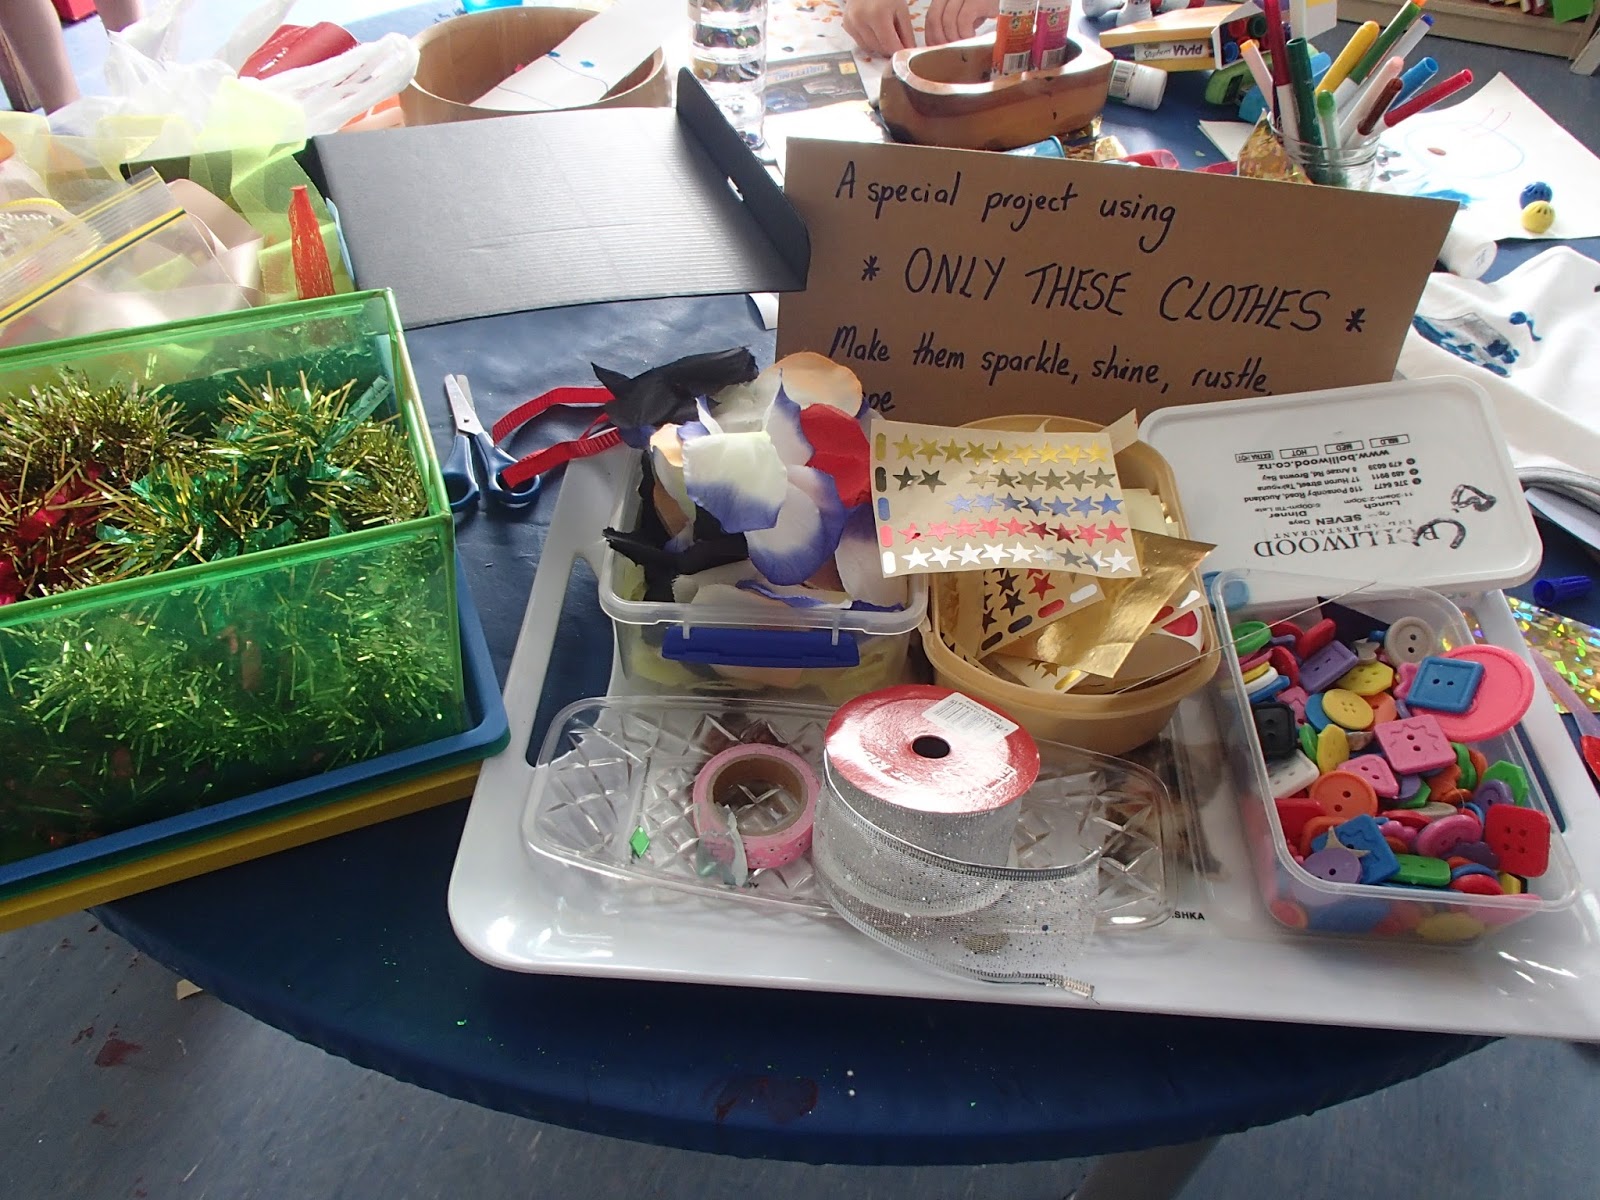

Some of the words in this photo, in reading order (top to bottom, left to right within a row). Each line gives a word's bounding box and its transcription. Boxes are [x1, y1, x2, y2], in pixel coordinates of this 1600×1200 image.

[1173, 44, 1203, 56] Vivid
[836, 160, 857, 199] A
[867, 171, 961, 219] special
[981, 181, 1078, 233] project
[1099, 195, 1175, 253] using
[904, 247, 1005, 300] ONLY
[1025, 262, 1133, 317] THESE
[1159, 276, 1331, 333] CLOTHES
[828, 325, 890, 363] Make
[913, 331, 965, 371] them
[981, 339, 1079, 387] sparkle,
[1091, 346, 1170, 394] shine,
[1192, 355, 1273, 398] rustle,
[862, 391, 896, 413] pe
[1251, 452, 1272, 461] EXTRA
[1291, 449, 1307, 457] HOT
[1257, 450, 1389, 470] www.bolliwood.co.nz
[1244, 494, 1281, 503] Auckland
[1364, 500, 1400, 509] Lunch
[1269, 510, 1307, 518] Dinner
[1289, 519, 1310, 527] Days
[1315, 514, 1362, 525] SEVEN
[1363, 519, 1412, 529] INDAN
[1273, 524, 1359, 539] RESTAURANT
[1171, 910, 1205, 920] SHKA
